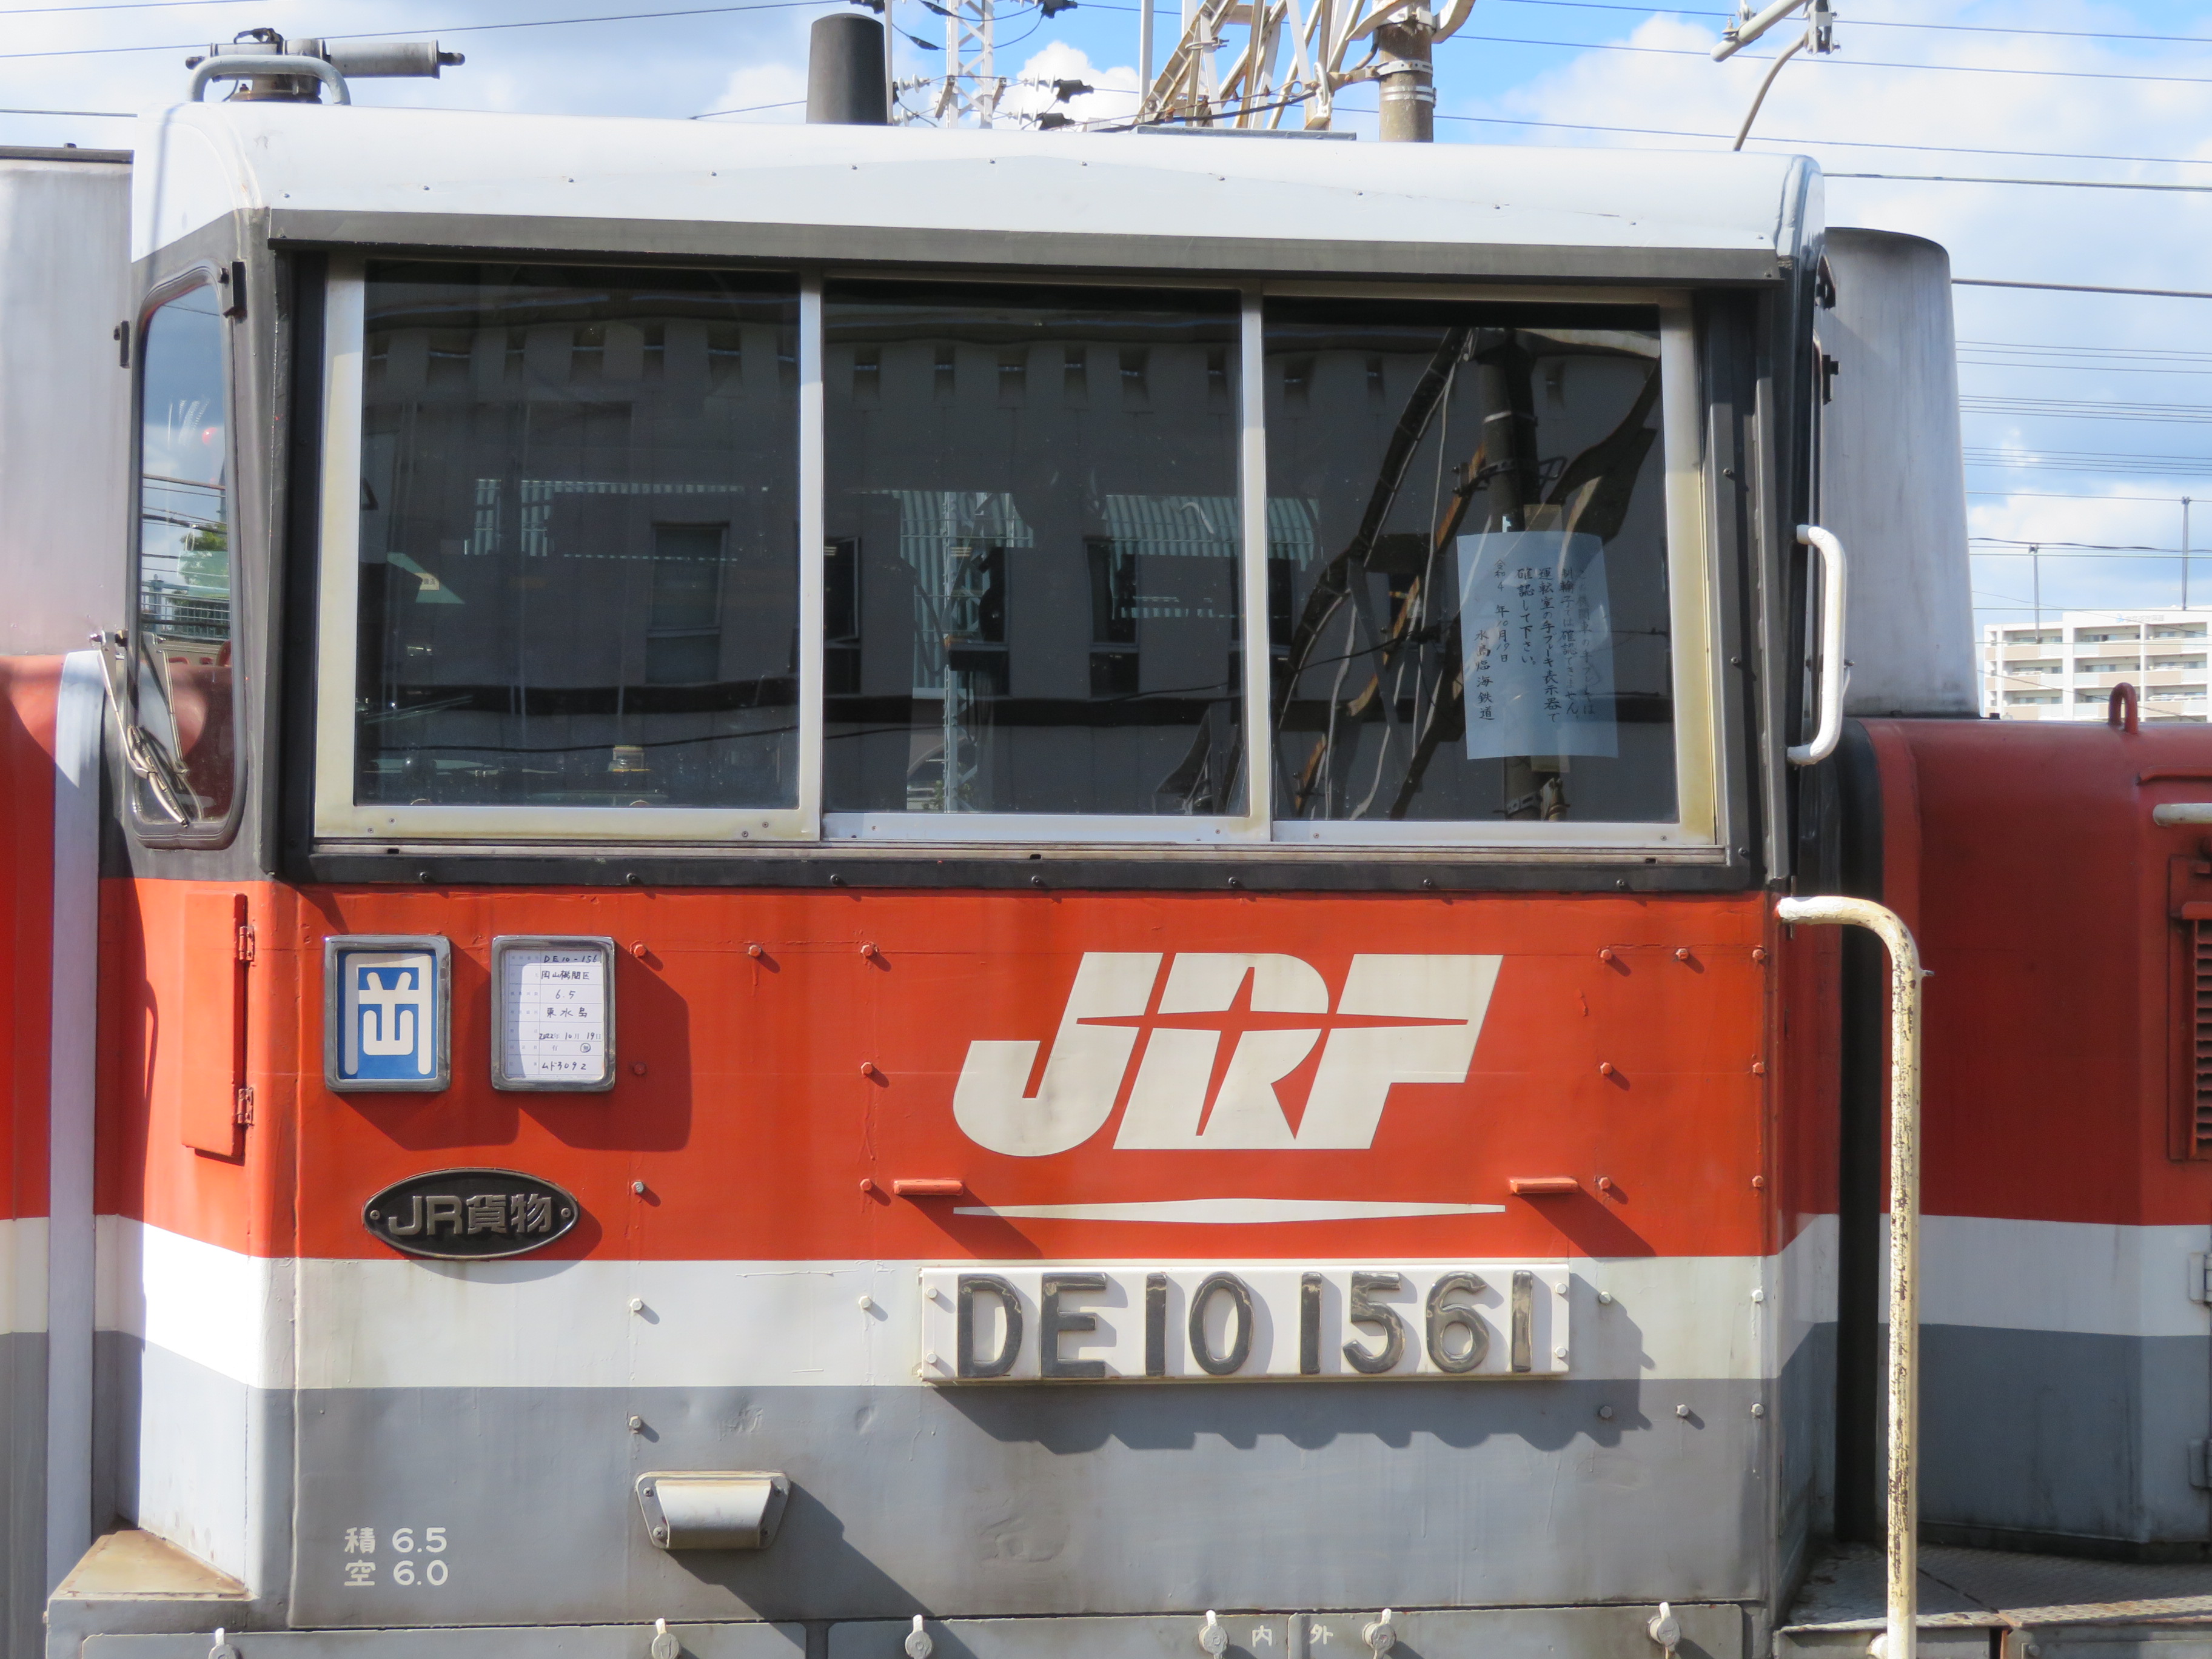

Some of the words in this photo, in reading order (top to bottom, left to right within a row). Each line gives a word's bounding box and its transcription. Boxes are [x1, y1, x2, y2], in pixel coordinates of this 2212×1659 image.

[1516, 567, 1537, 666] 確認して下さい。
[1473, 629, 1495, 721] 水島臨海鉄道
[555, 989, 576, 1000] 6.5
[546, 1006, 588, 1018] 東水島
[953, 951, 1504, 1158] JRF
[388, 1193, 552, 1236] JR貨物
[344, 1526, 376, 1553] 積
[392, 1526, 447, 1553] 6.5
[344, 1559, 376, 1586] 空
[393, 1559, 449, 1586] 6.0
[1252, 1624, 1273, 1647] 内
[1310, 1623, 1334, 1645] 外
